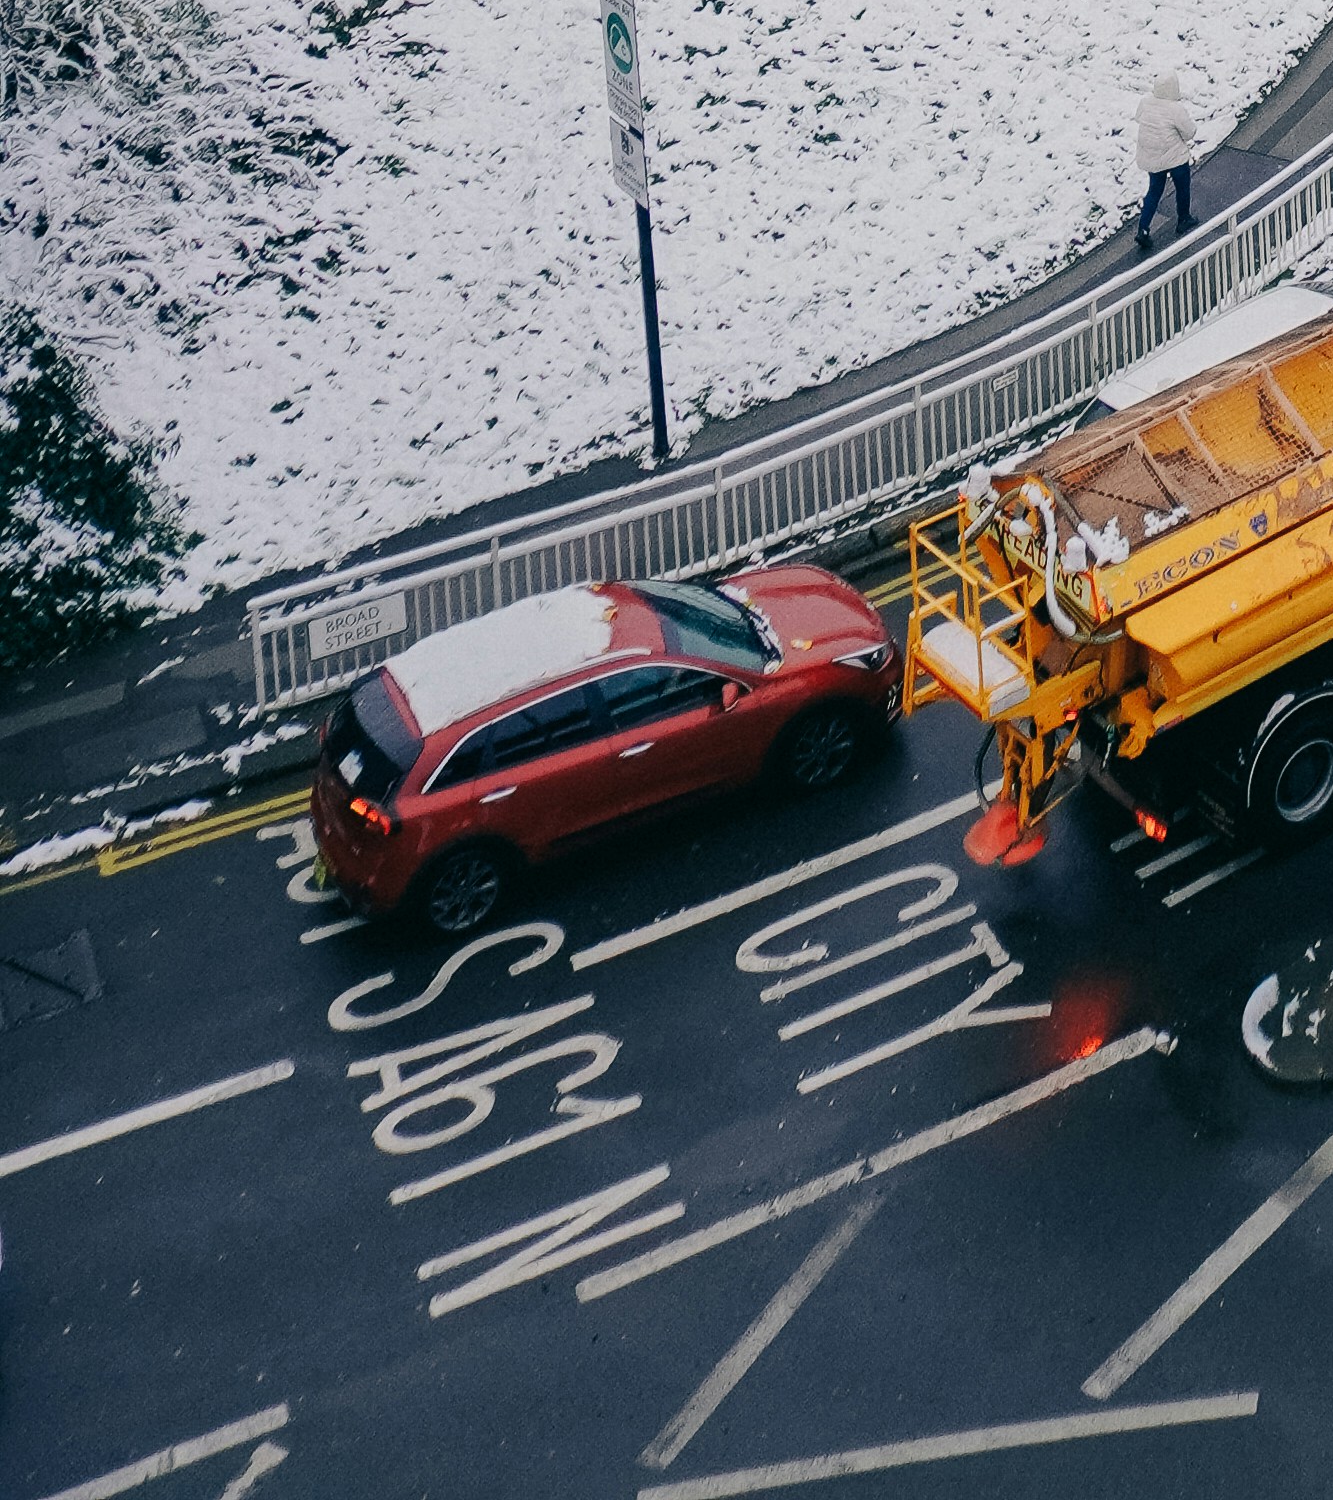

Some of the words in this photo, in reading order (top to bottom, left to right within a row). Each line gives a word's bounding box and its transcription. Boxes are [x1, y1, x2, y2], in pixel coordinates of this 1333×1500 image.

[326, 606, 380, 634] BROAD
[325, 621, 383, 651] STREET
[735, 861, 1052, 1095] CITY
